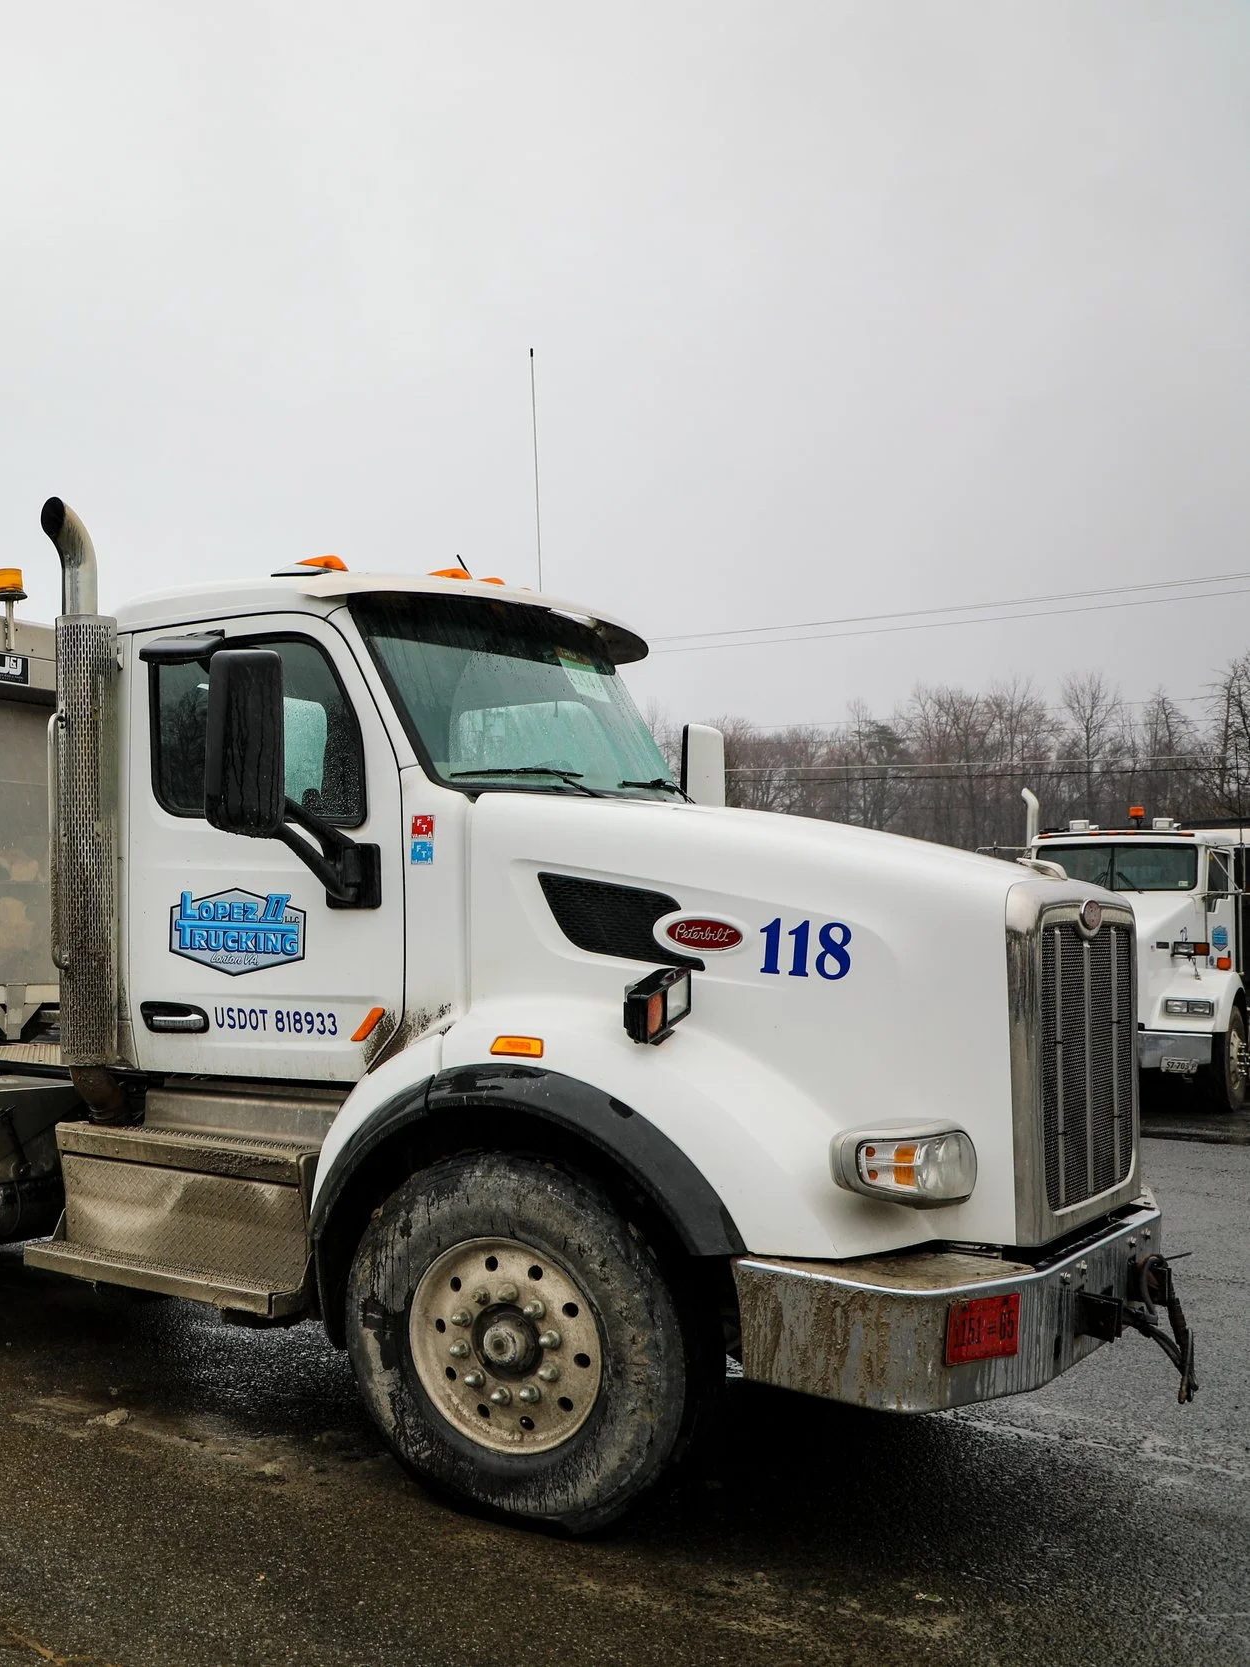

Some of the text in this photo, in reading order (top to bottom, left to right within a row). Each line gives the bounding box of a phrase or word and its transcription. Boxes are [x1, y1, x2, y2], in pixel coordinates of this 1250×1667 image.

[181, 891, 259, 922] LOPEZ
[260, 894, 291, 923] II
[175, 920, 300, 956] TRUCKING
[675, 923, 735, 942] Peterbilt
[760, 917, 851, 981] 118
[214, 1006, 338, 1036] USDOT 818933
